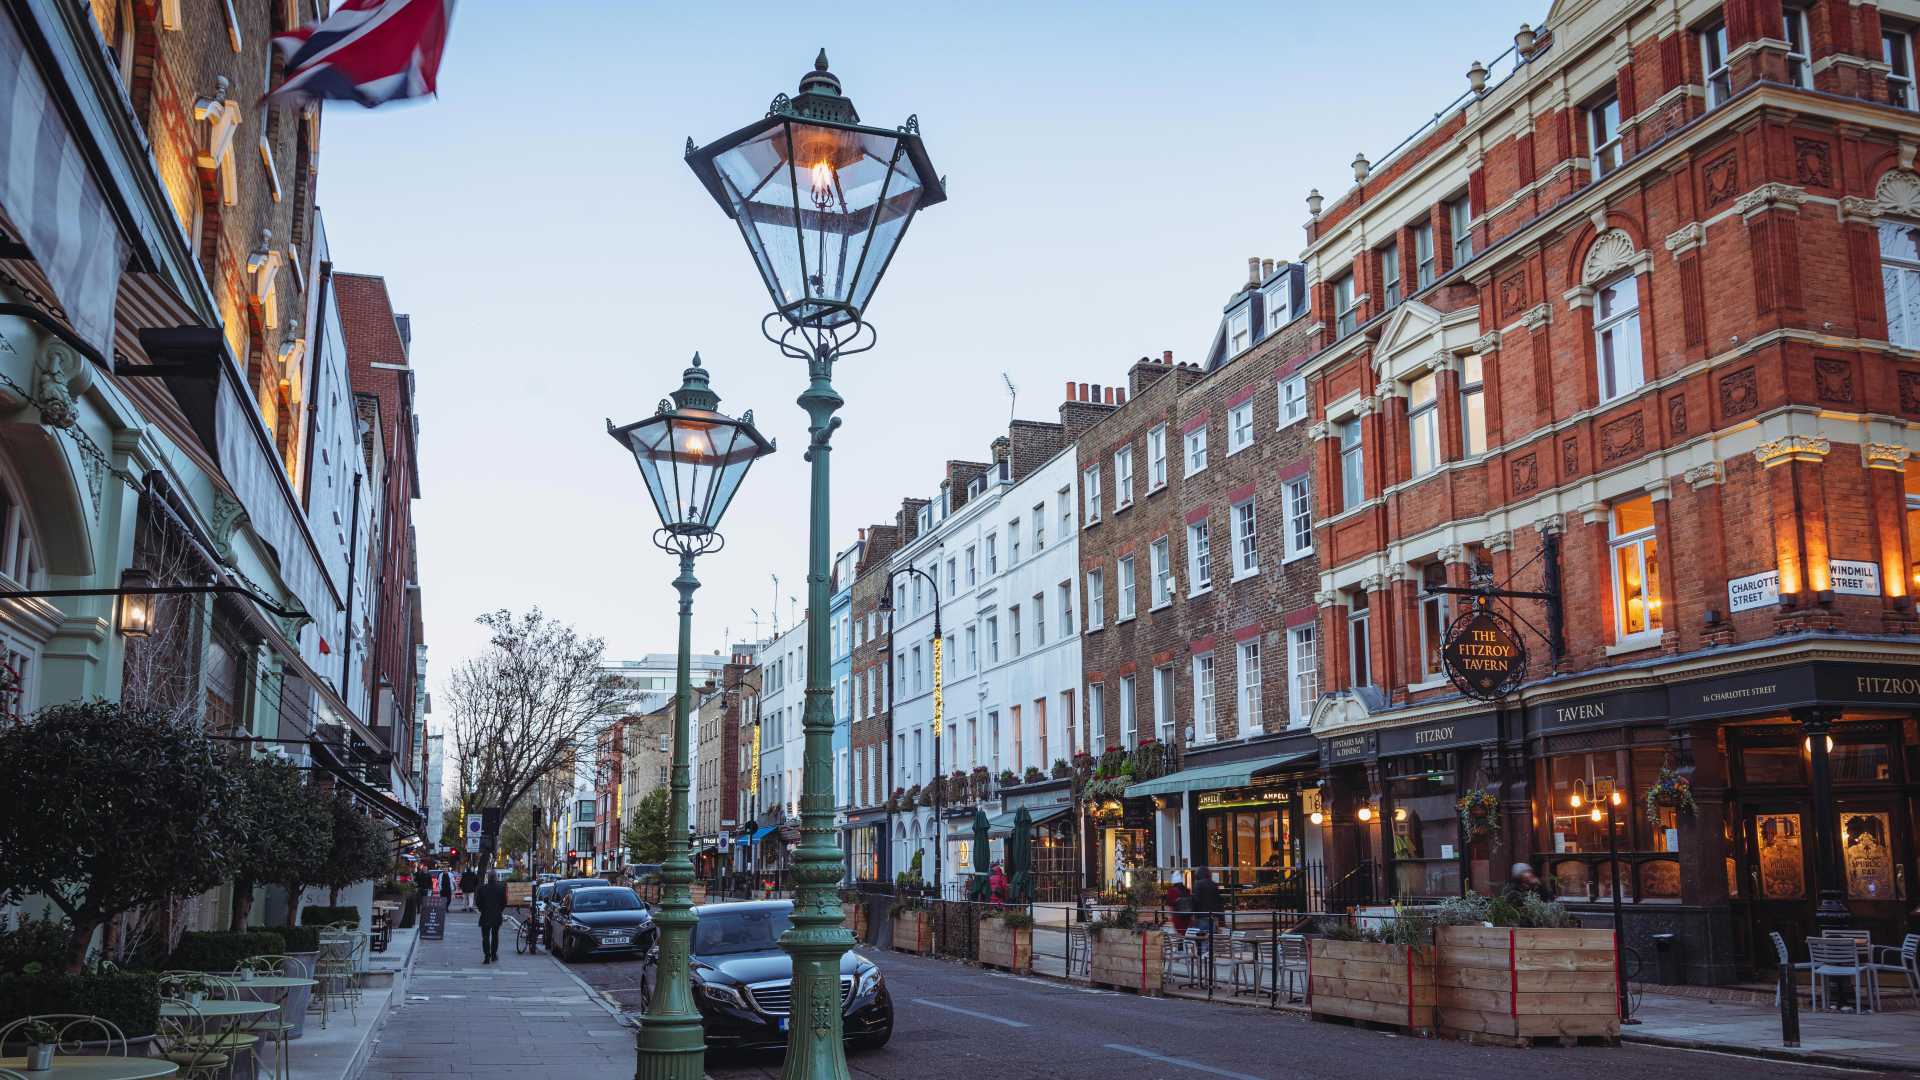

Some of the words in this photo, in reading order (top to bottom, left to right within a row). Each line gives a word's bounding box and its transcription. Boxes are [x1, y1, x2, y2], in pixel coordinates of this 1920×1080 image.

[1829, 565, 1873, 577] WINDMILL
[1731, 575, 1779, 594] CHARLOTTE
[1830, 577, 1864, 589] STREET
[1732, 591, 1763, 607] STREET
[1471, 630, 1497, 642] THE
[1459, 644, 1511, 657] FITZROY
[1462, 659, 1509, 672] TAVERN
[1710, 688, 1751, 701] CHARLOTTE
[1751, 684, 1777, 697] STREET
[1856, 676, 1920, 695] FITZROY
[1556, 702, 1605, 722] TAVERN
[1415, 726, 1455, 744] FITZROY
[1263, 792, 1289, 800] AMPELI
